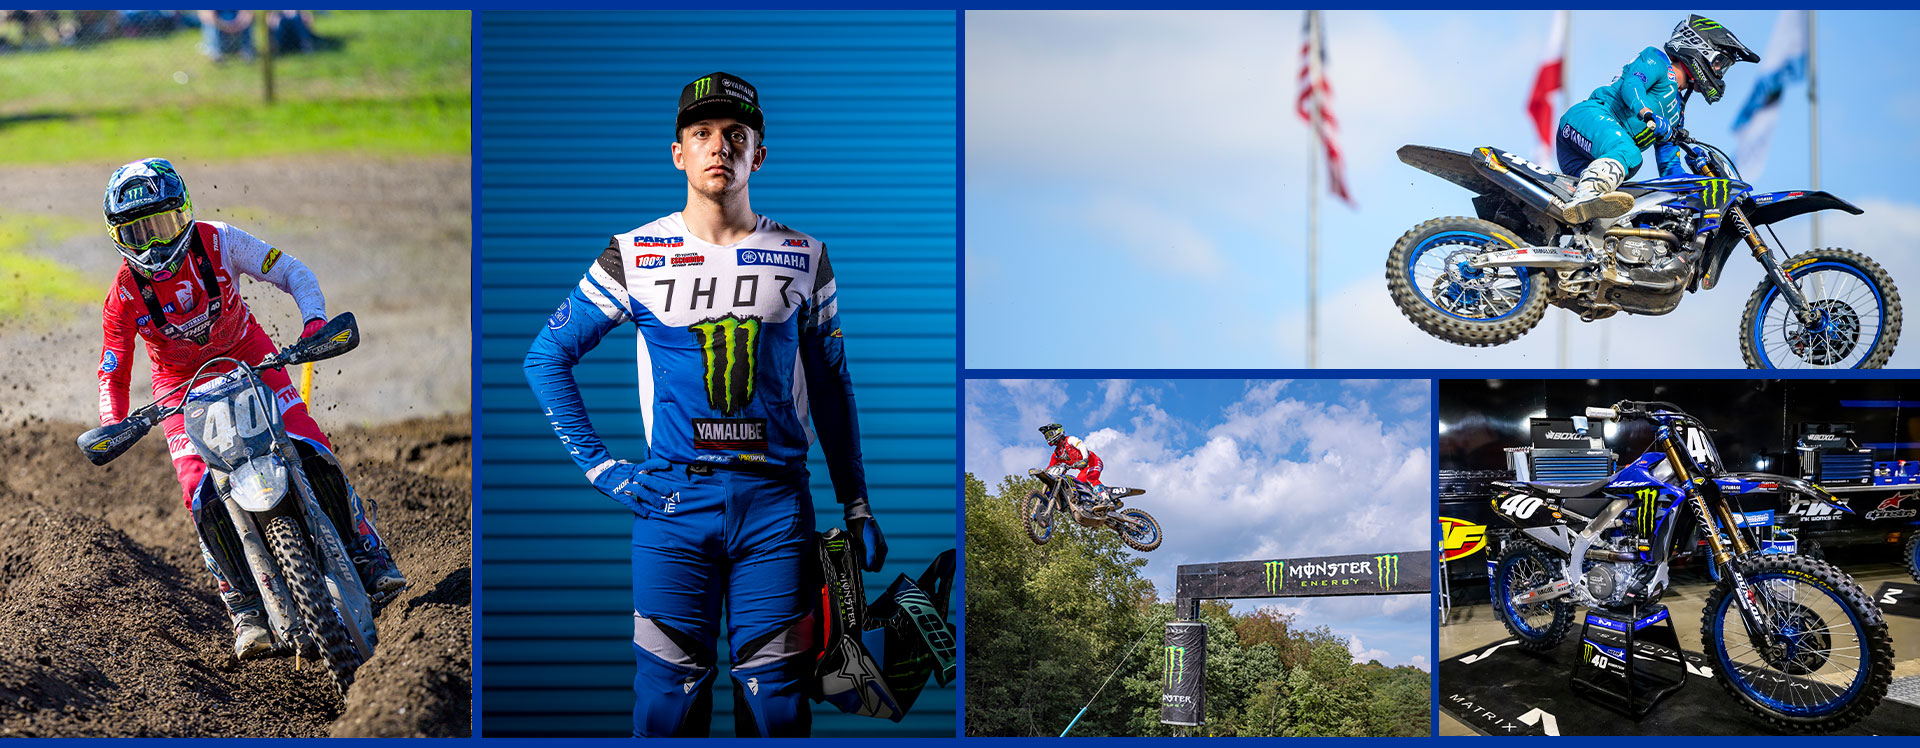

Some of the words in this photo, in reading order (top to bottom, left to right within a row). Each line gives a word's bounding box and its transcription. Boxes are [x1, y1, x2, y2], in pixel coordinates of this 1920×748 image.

[1571, 127, 1592, 153] YAMAHA
[634, 236, 684, 244] PARTS
[781, 239, 810, 248] AMA
[638, 256, 664, 267] 100%
[671, 256, 704, 264] ESCONDIDO
[757, 253, 806, 270] YAMAHA
[655, 275, 794, 312] THOR
[210, 302, 220, 311] 40
[183, 320, 211, 338] THOR
[203, 386, 271, 454] 40
[696, 423, 763, 440] YAMALUBE
[612, 478, 630, 495] THOR
[1112, 487, 1127, 495] 40
[1500, 494, 1544, 519] 40
[1289, 561, 1373, 579] MONSTER
[1301, 578, 1360, 587] ENERGY
[1787, 569, 1834, 592] DUNLOP
[836, 581, 847, 621] ENERGY
[840, 572, 857, 628] MONSTER
[1591, 654, 1608, 669] 40
[1449, 693, 1518, 732] MATRIX
